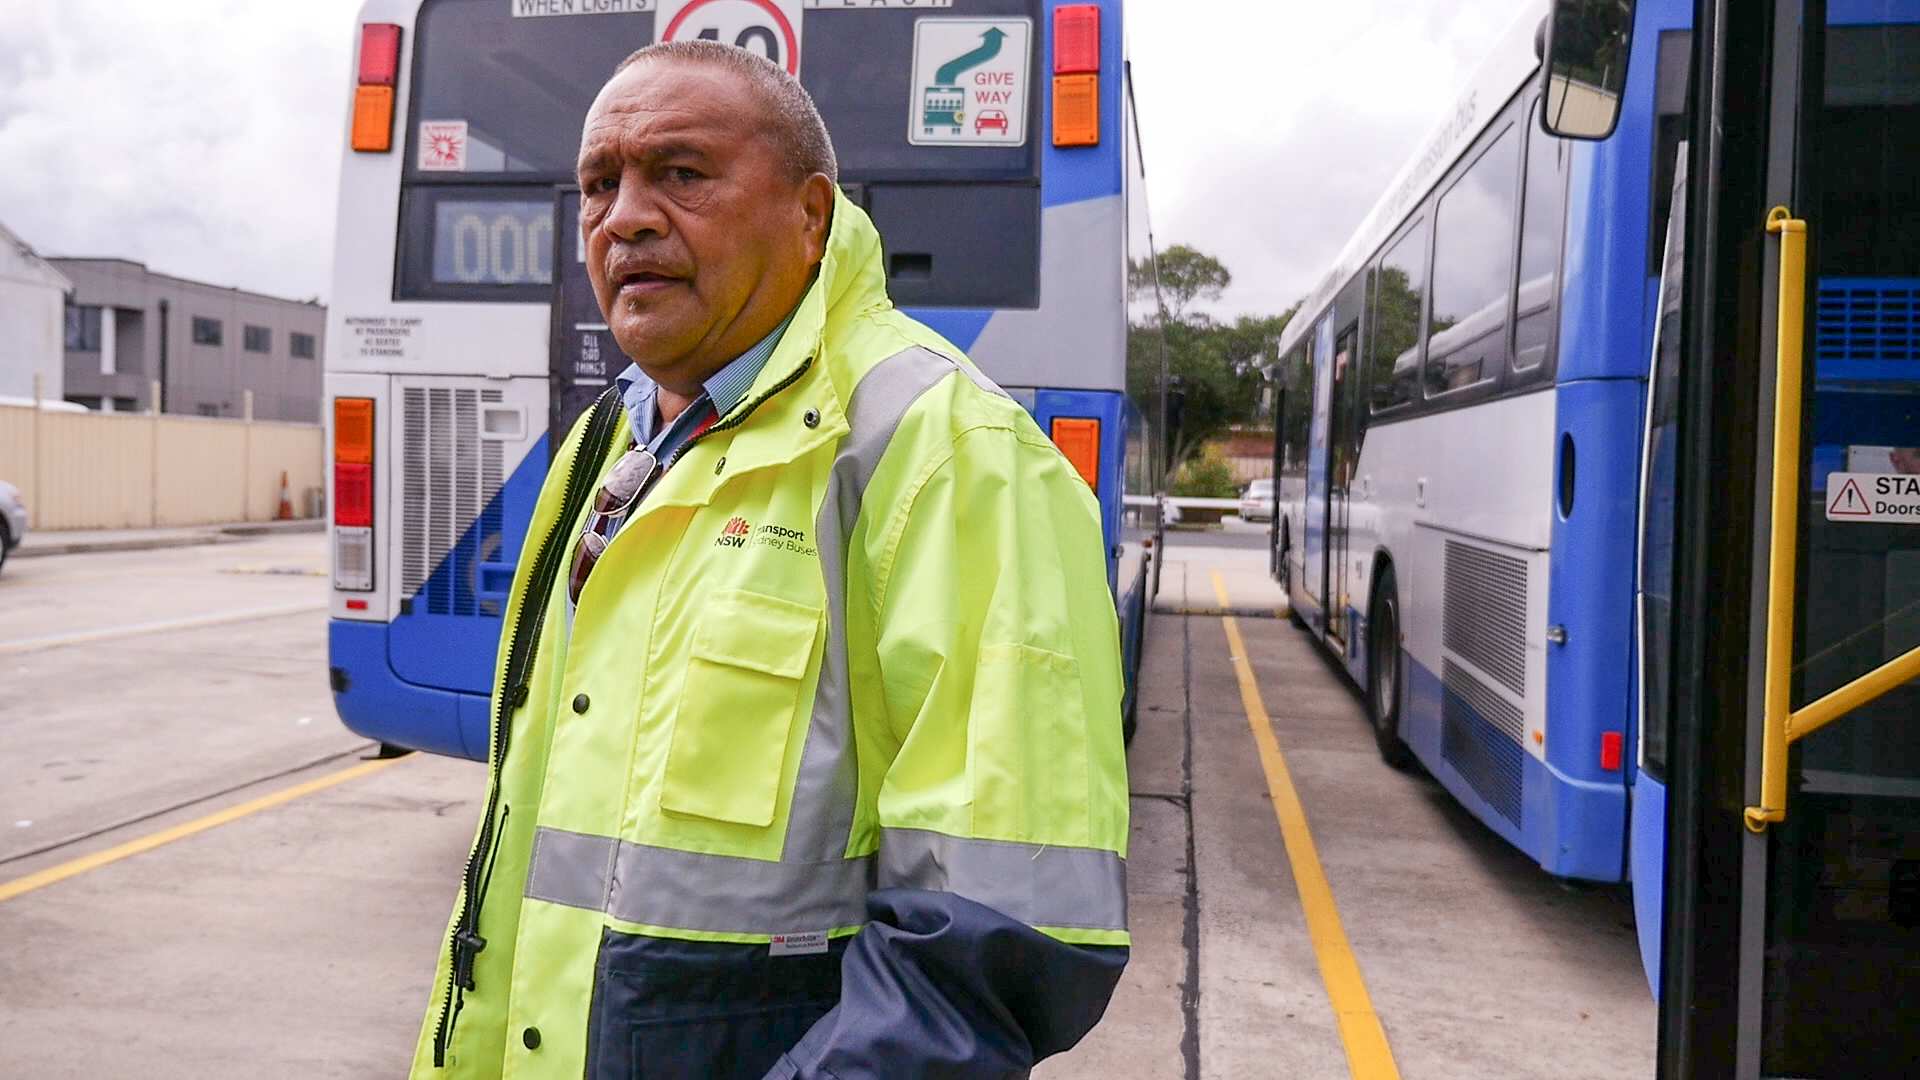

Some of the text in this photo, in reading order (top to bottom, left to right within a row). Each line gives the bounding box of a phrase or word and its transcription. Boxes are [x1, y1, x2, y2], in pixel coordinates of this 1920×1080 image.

[519, 0, 573, 14] WHEN
[975, 72, 1014, 86] GIVE
[975, 91, 1012, 104] WAY
[1875, 501, 1920, 515] Doors
[757, 524, 805, 542] nsport
[714, 535, 746, 548] NSW
[786, 540, 817, 557] Buses
